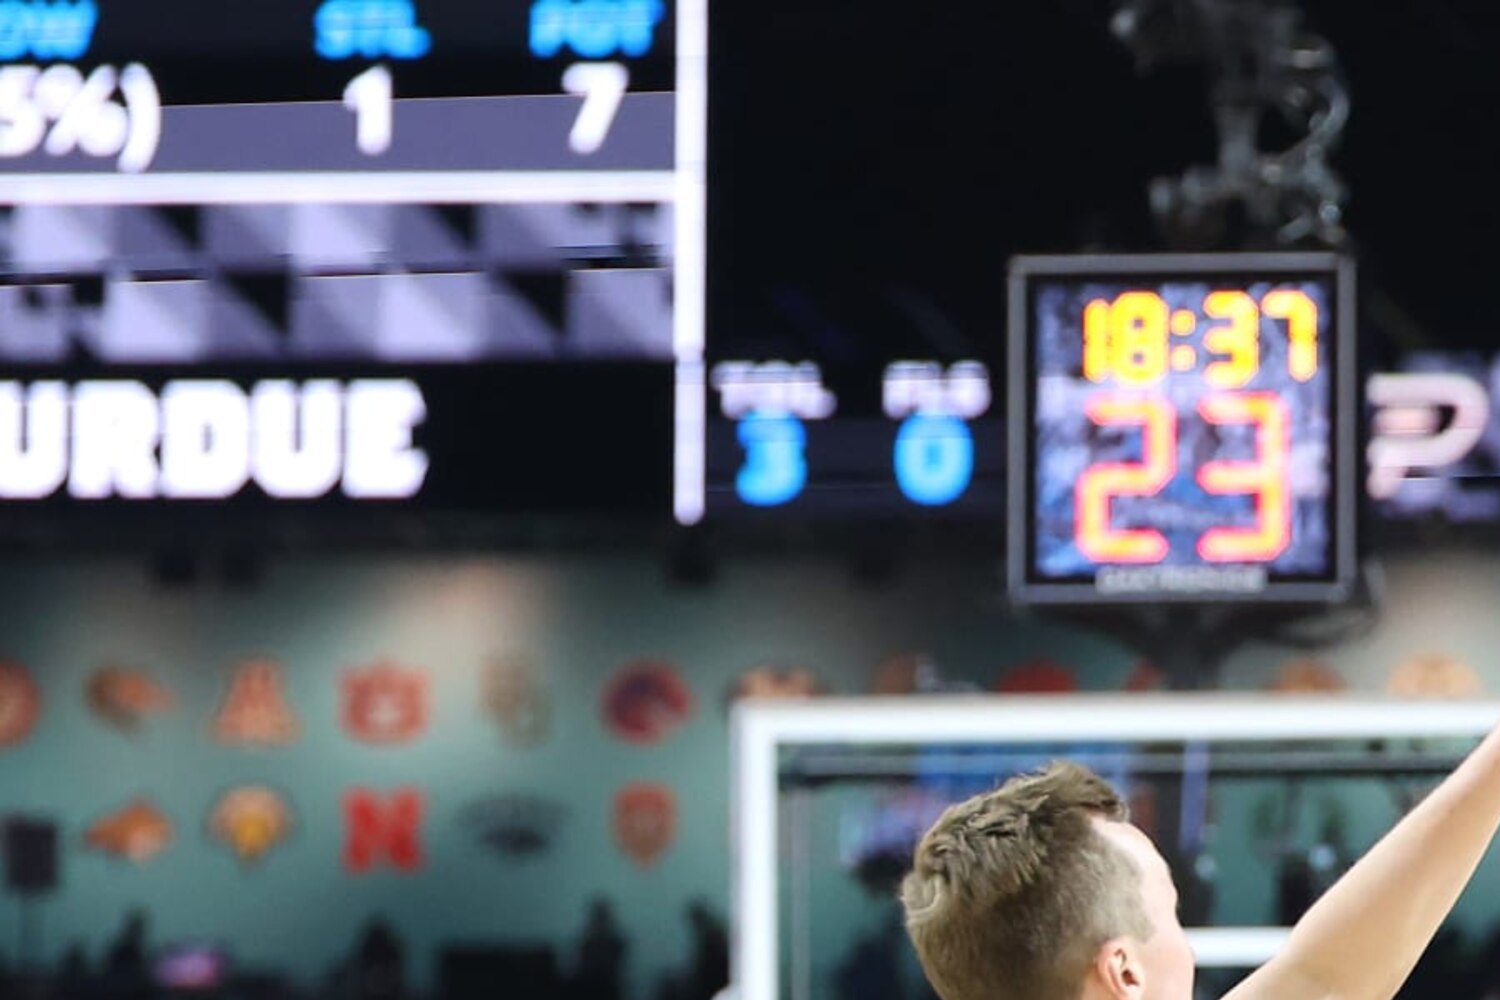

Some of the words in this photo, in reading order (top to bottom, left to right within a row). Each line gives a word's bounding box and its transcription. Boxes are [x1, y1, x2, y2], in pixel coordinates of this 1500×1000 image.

[342, 62, 393, 155] 1
[561, 61, 629, 154] 7
[1083, 290, 1318, 384] 18:37
[0, 379, 428, 500] URDUE
[893, 410, 974, 507] 0
[1075, 390, 1291, 563] 23
